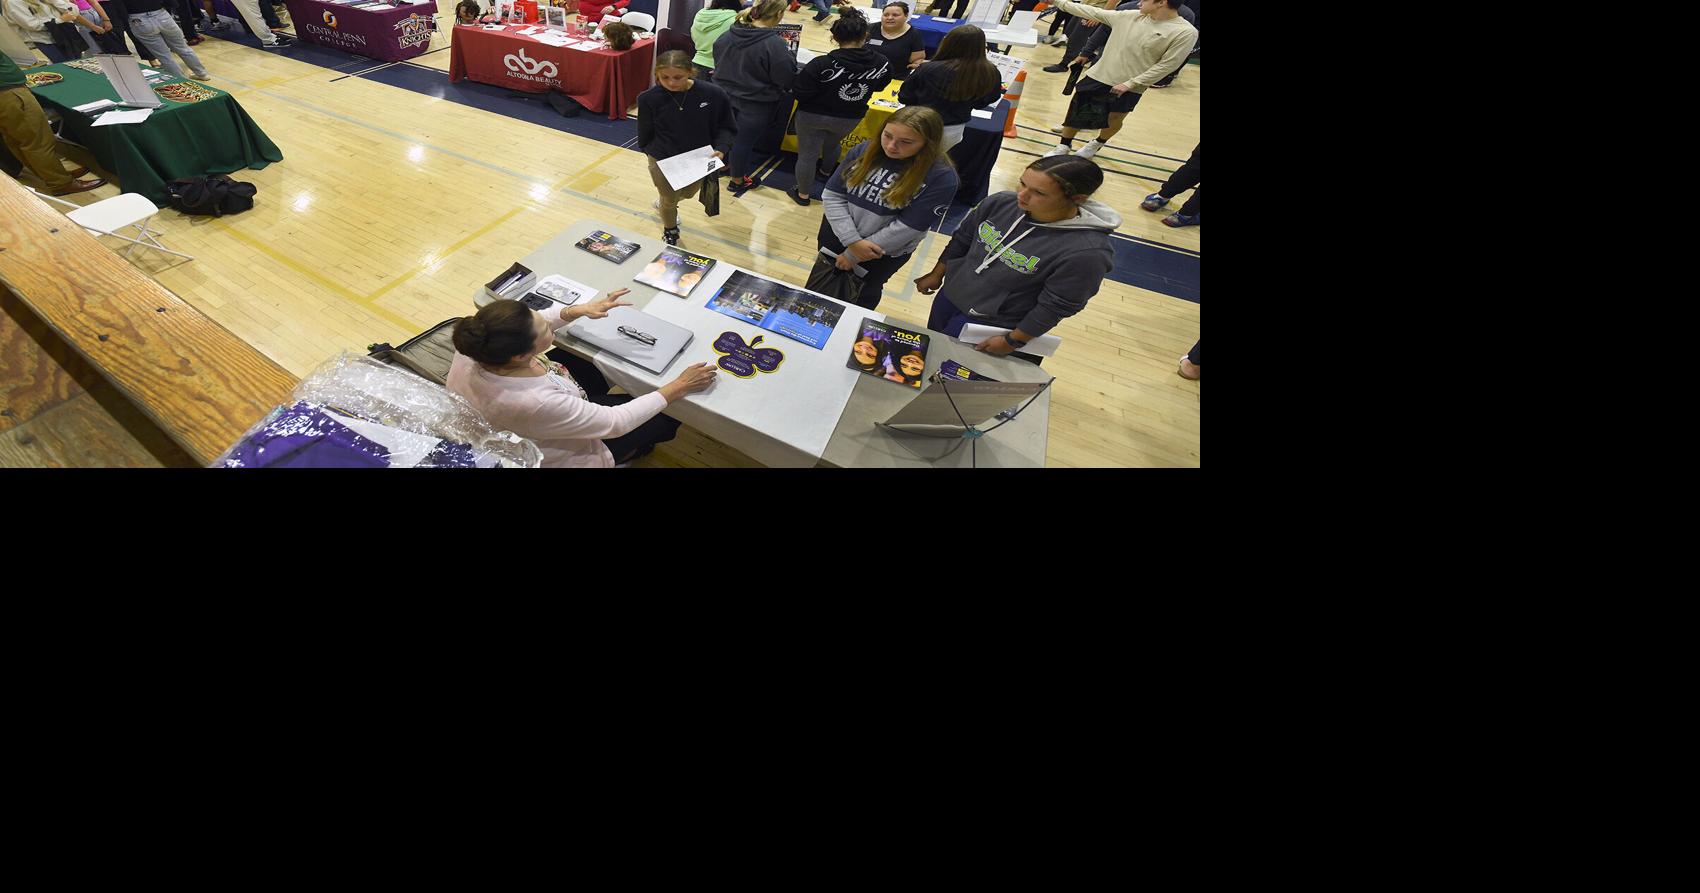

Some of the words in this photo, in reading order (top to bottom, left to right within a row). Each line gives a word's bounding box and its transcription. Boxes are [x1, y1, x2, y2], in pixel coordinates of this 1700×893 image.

[401, 31, 432, 47] KNIGHTS
[506, 71, 535, 81] ALTOONA
[535, 76, 562, 86] BEAUTY
[893, 330, 921, 342] you.
